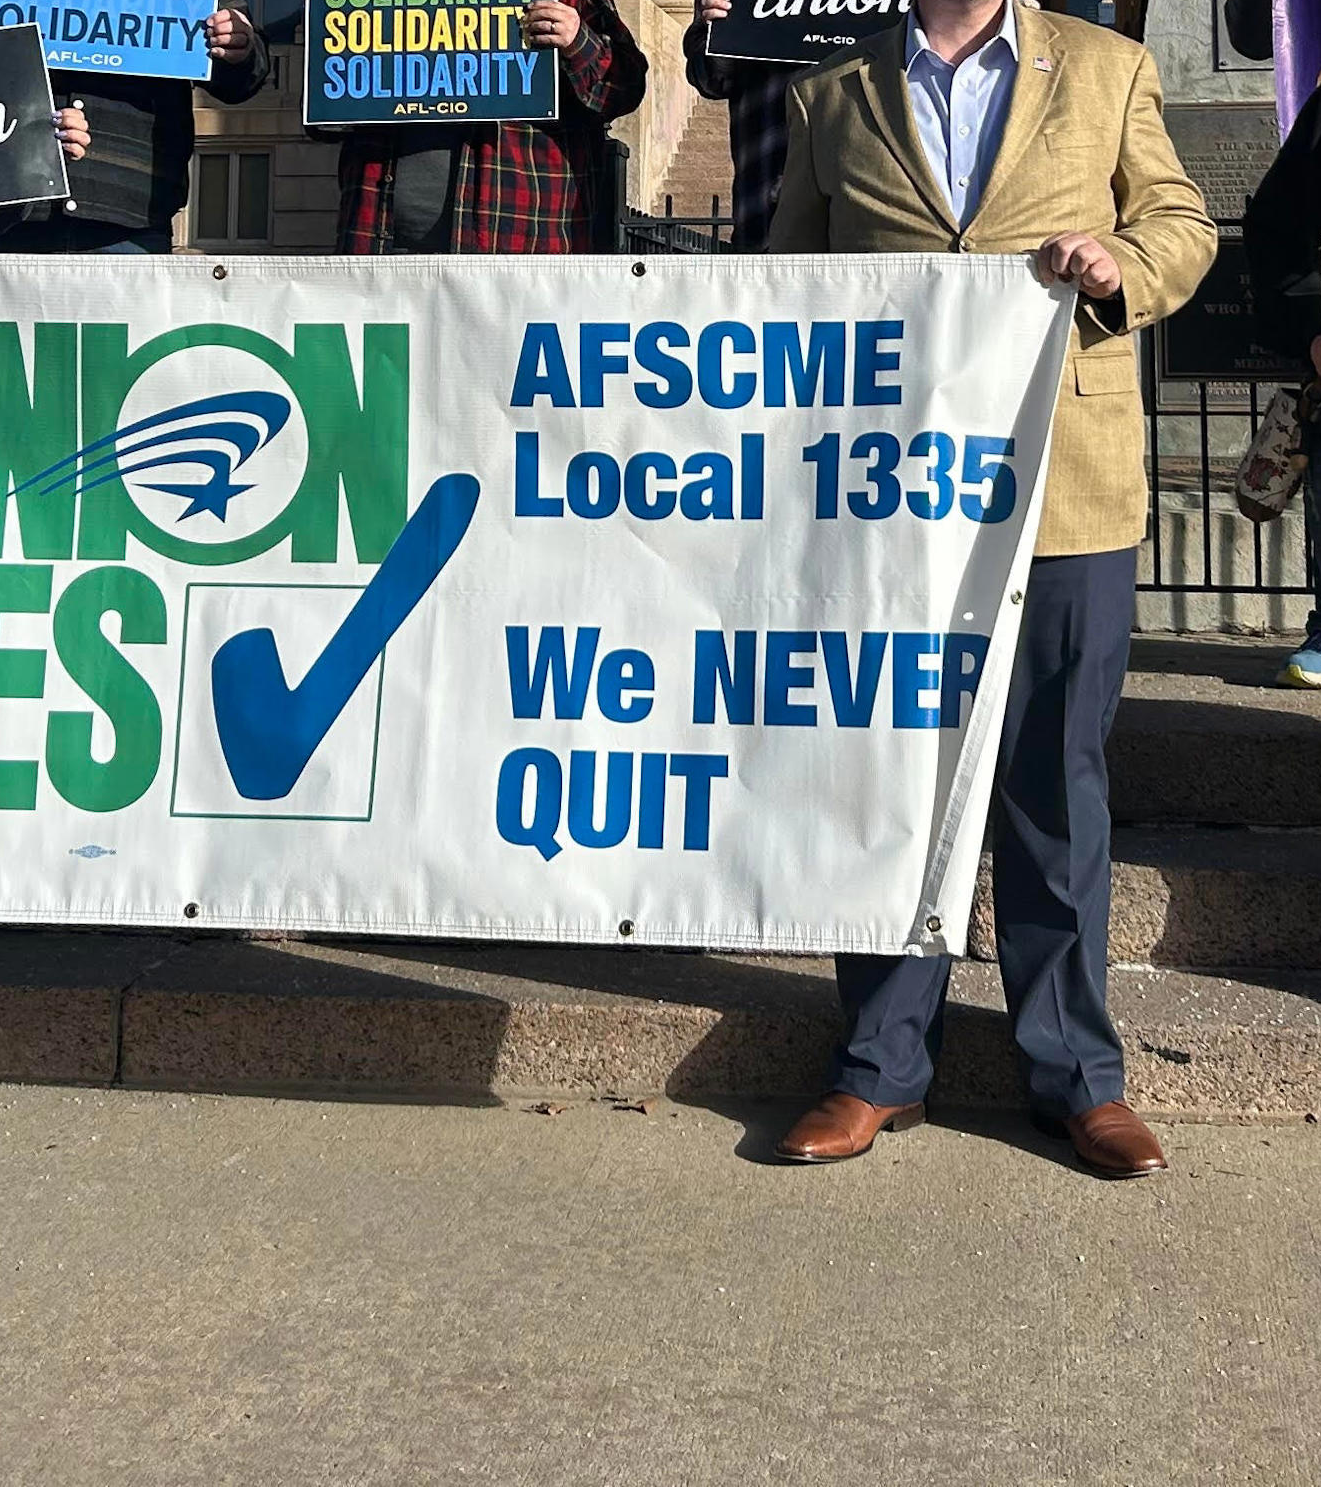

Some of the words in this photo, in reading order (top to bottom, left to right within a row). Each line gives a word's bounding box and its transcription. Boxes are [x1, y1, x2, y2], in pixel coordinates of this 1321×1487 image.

[46, 50, 123, 67] AFL-CIO
[802, 34, 856, 45] AFL-CIO
[323, 51, 540, 100] SOLIDARITY
[393, 101, 468, 115] AFL-CIO
[510, 320, 904, 409] AFSCME
[514, 431, 765, 521] Local
[801, 431, 1017, 524] 1335
[506, 625, 655, 722] We
[692, 629, 990, 730] NEVER
[496, 746, 729, 862] QUIT
